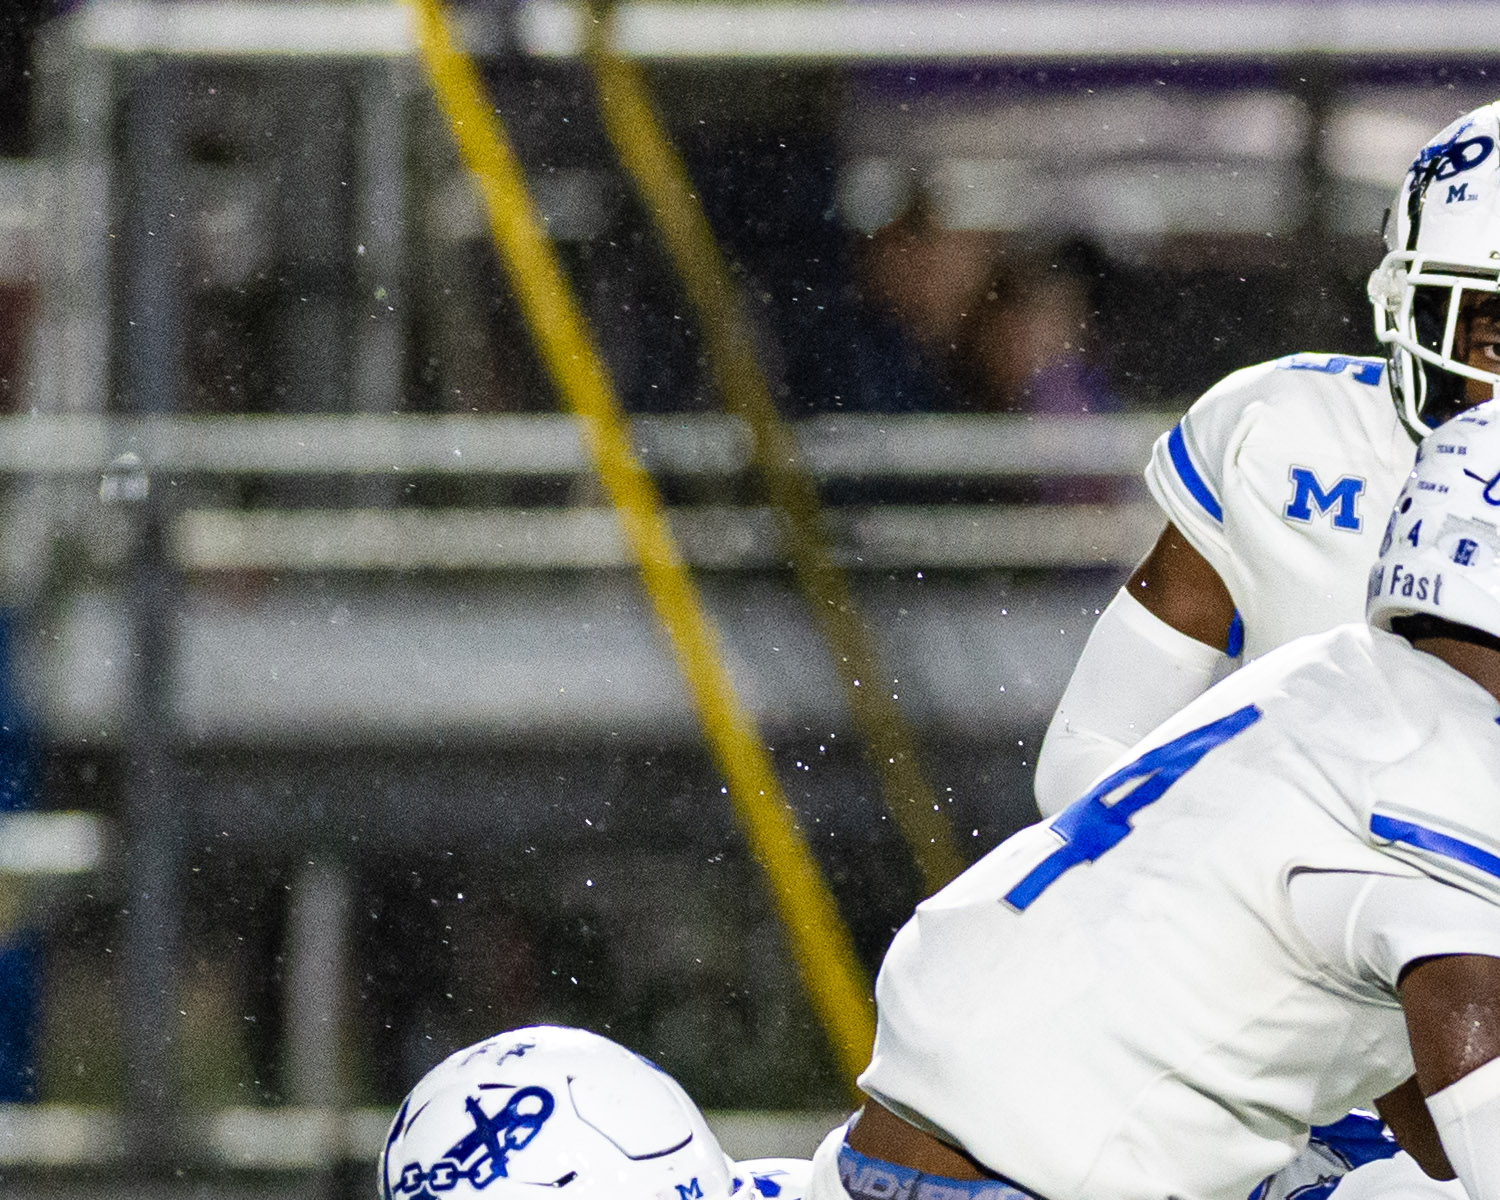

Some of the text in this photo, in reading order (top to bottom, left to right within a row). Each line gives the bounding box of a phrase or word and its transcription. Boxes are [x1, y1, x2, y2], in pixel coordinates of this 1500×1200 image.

[1446, 182, 1469, 204] M
[1286, 466, 1364, 531] M
[1407, 519, 1423, 547] 4
[1390, 564, 1443, 606] Fast
[1000, 703, 1264, 914] 4
